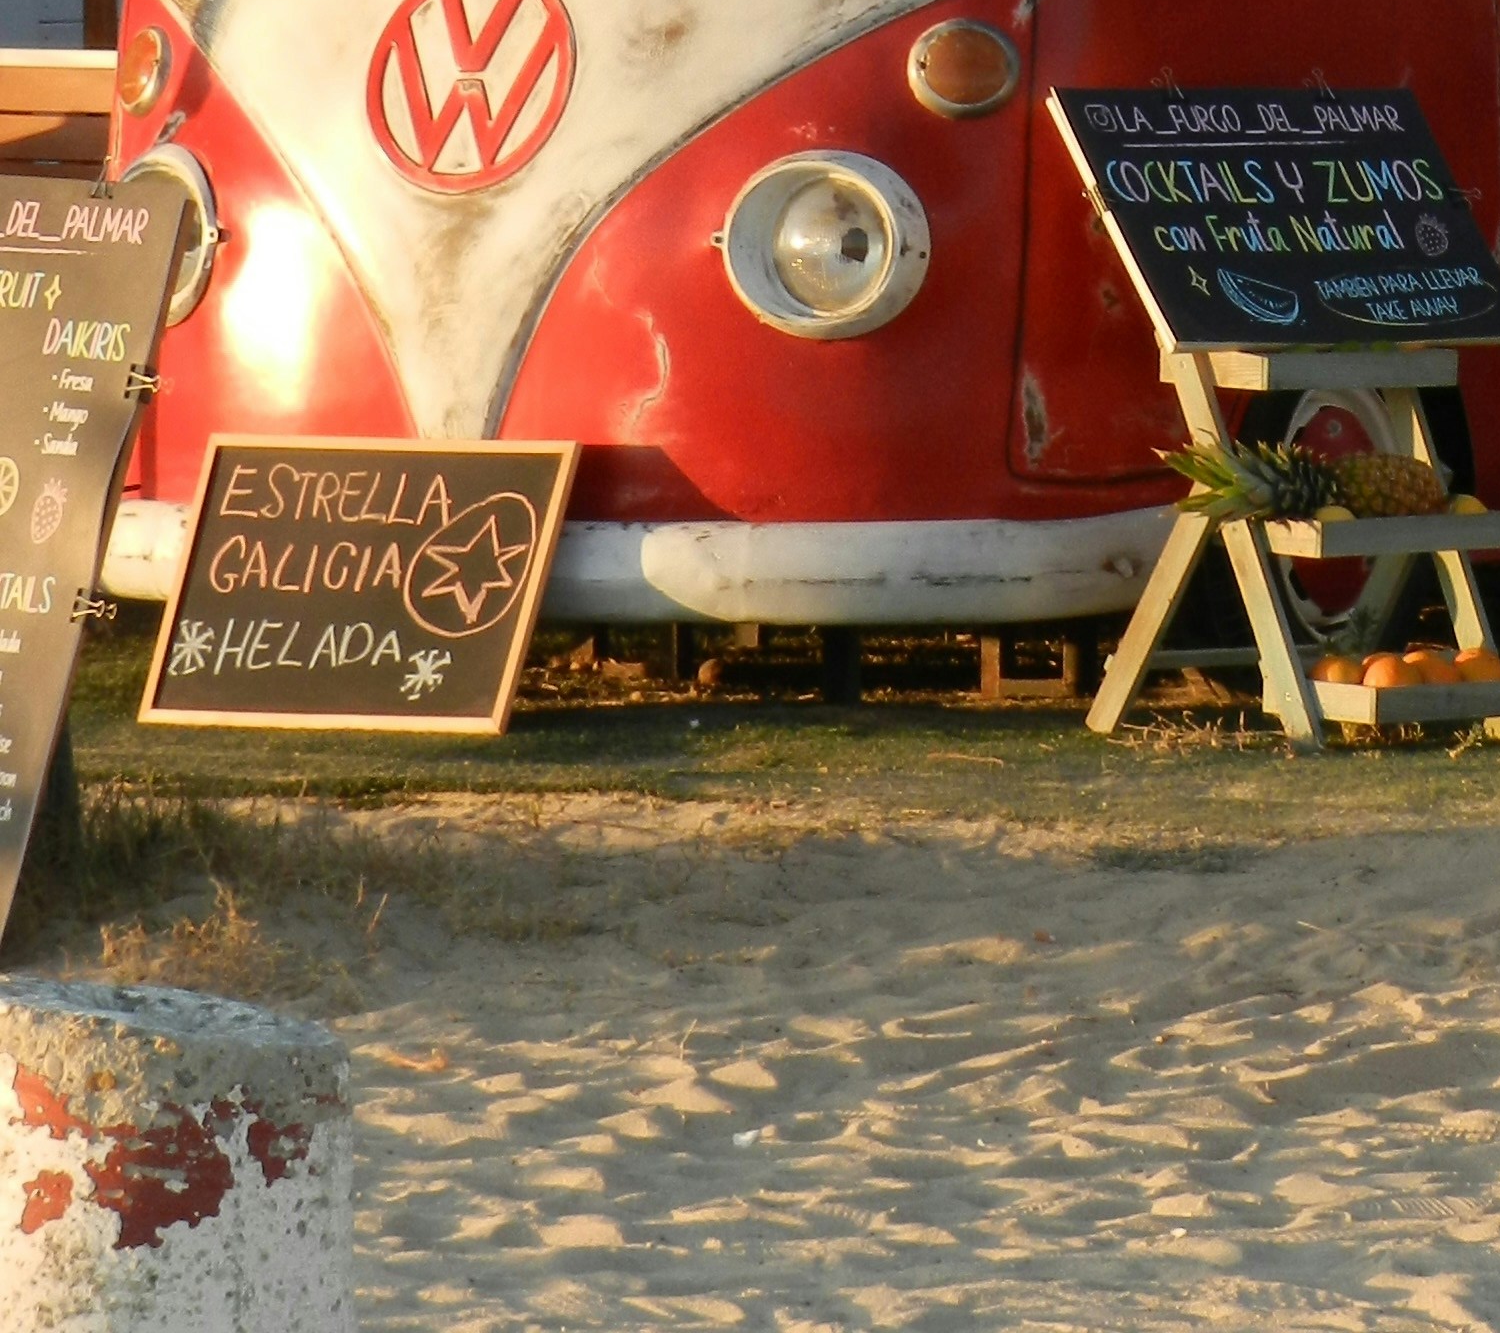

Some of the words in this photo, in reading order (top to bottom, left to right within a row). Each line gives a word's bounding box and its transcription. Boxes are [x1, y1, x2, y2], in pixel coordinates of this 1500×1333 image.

[1106, 160, 1275, 204] COCKTAILS
[1312, 158, 1444, 201] ZUMOS
[1153, 225, 1206, 252] con
[1205, 210, 1292, 252] Fruta
[1289, 208, 1406, 252] Natural
[1377, 273, 1423, 295] PARA
[1421, 266, 1484, 291] LLEVAR
[1365, 300, 1409, 323] TAKE
[1410, 295, 1459, 318] AWAY
[42, 318, 131, 361] DAIKIRIS
[58, 367, 94, 392] Fresa
[219, 464, 452, 527] ESTRELLA
[209, 534, 403, 594] GALICIA
[213, 618, 402, 676] HELADA
